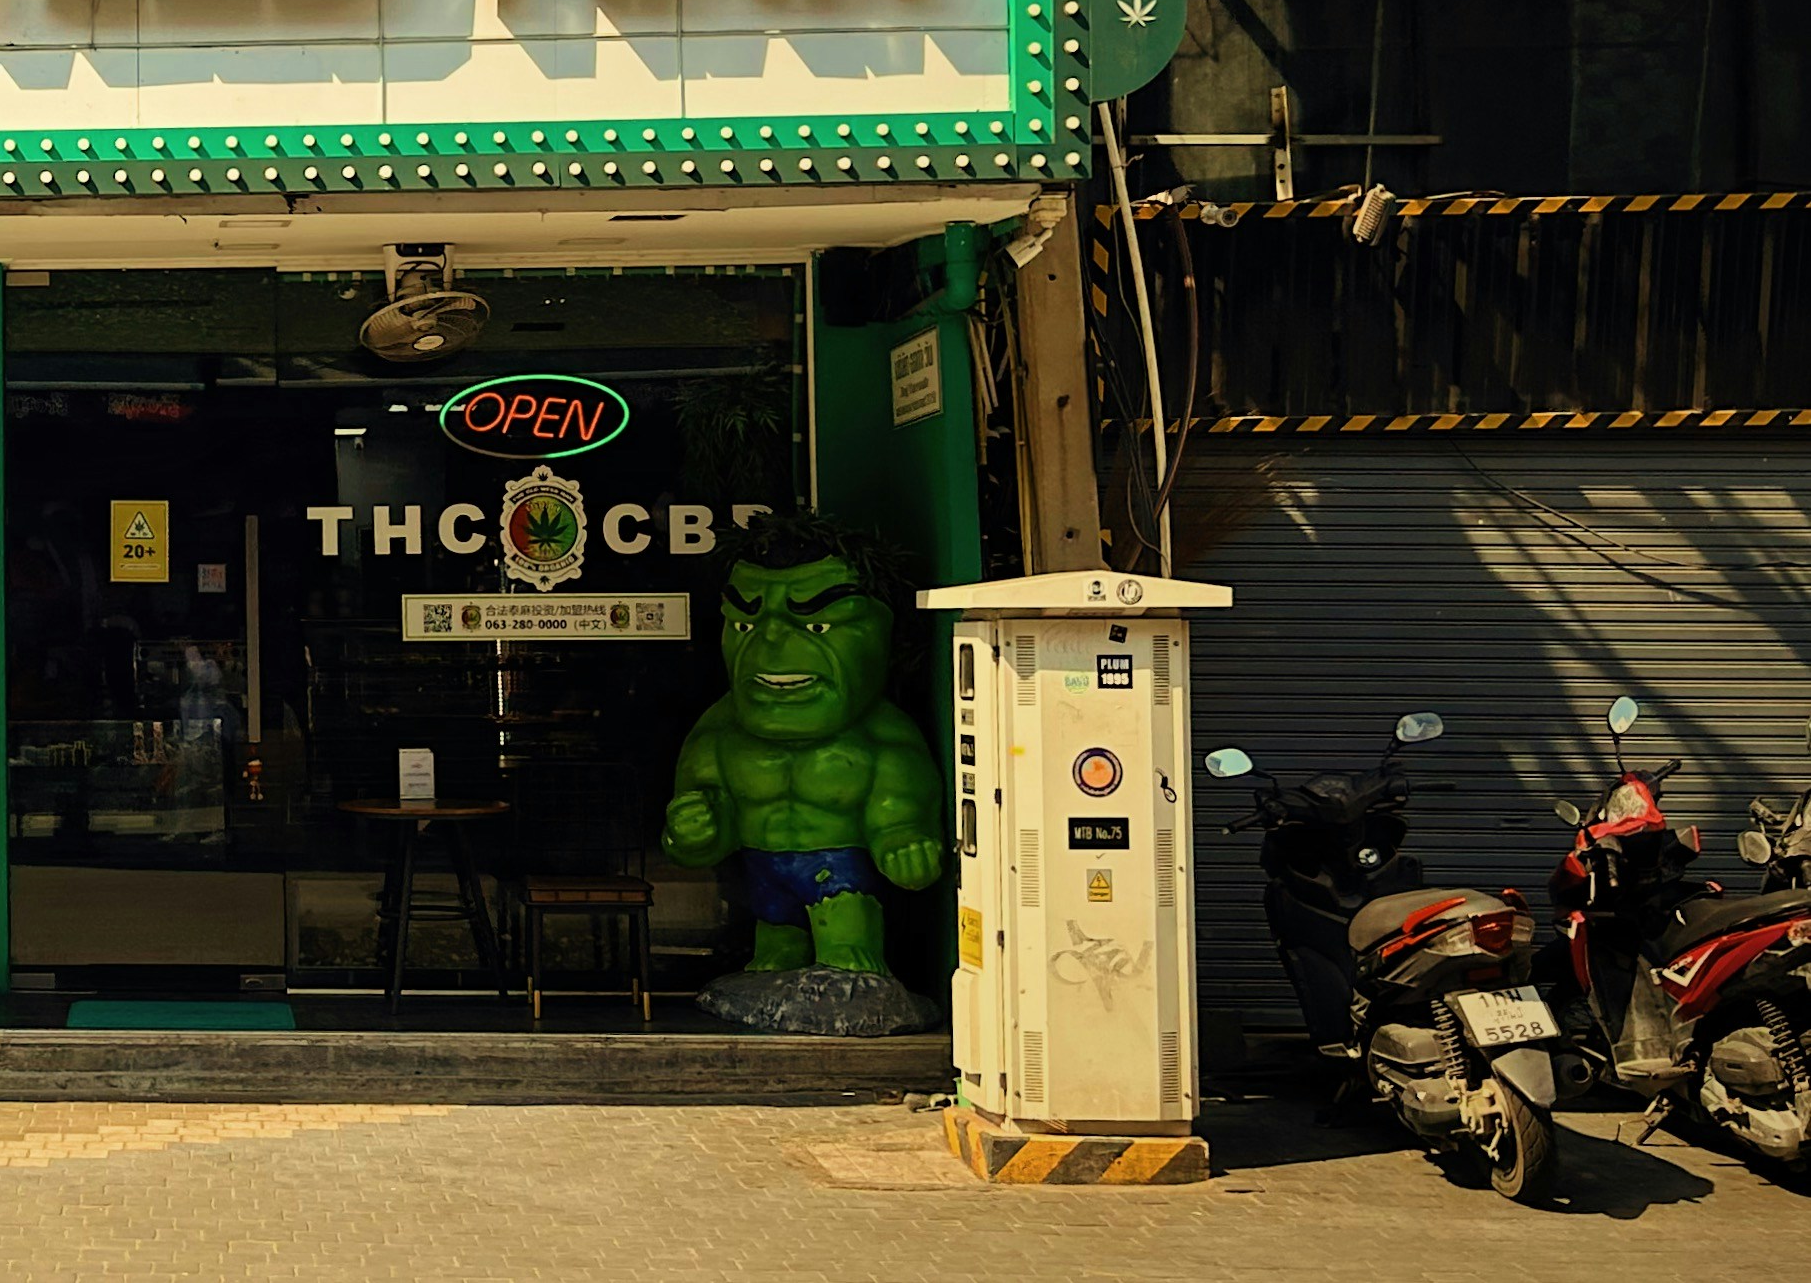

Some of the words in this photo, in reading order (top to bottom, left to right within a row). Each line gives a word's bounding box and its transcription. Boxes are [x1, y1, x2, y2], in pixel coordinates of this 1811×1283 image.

[465, 391, 605, 442] OPEN
[306, 503, 488, 556] THC
[123, 544, 156, 559] 20+
[485, 619, 567, 630] 063-280-0000
[1100, 658, 1130, 670] PLUM
[1101, 672, 1130, 685] 1995
[1073, 826, 1093, 840] MTB
[1484, 1021, 1545, 1042] 5528
